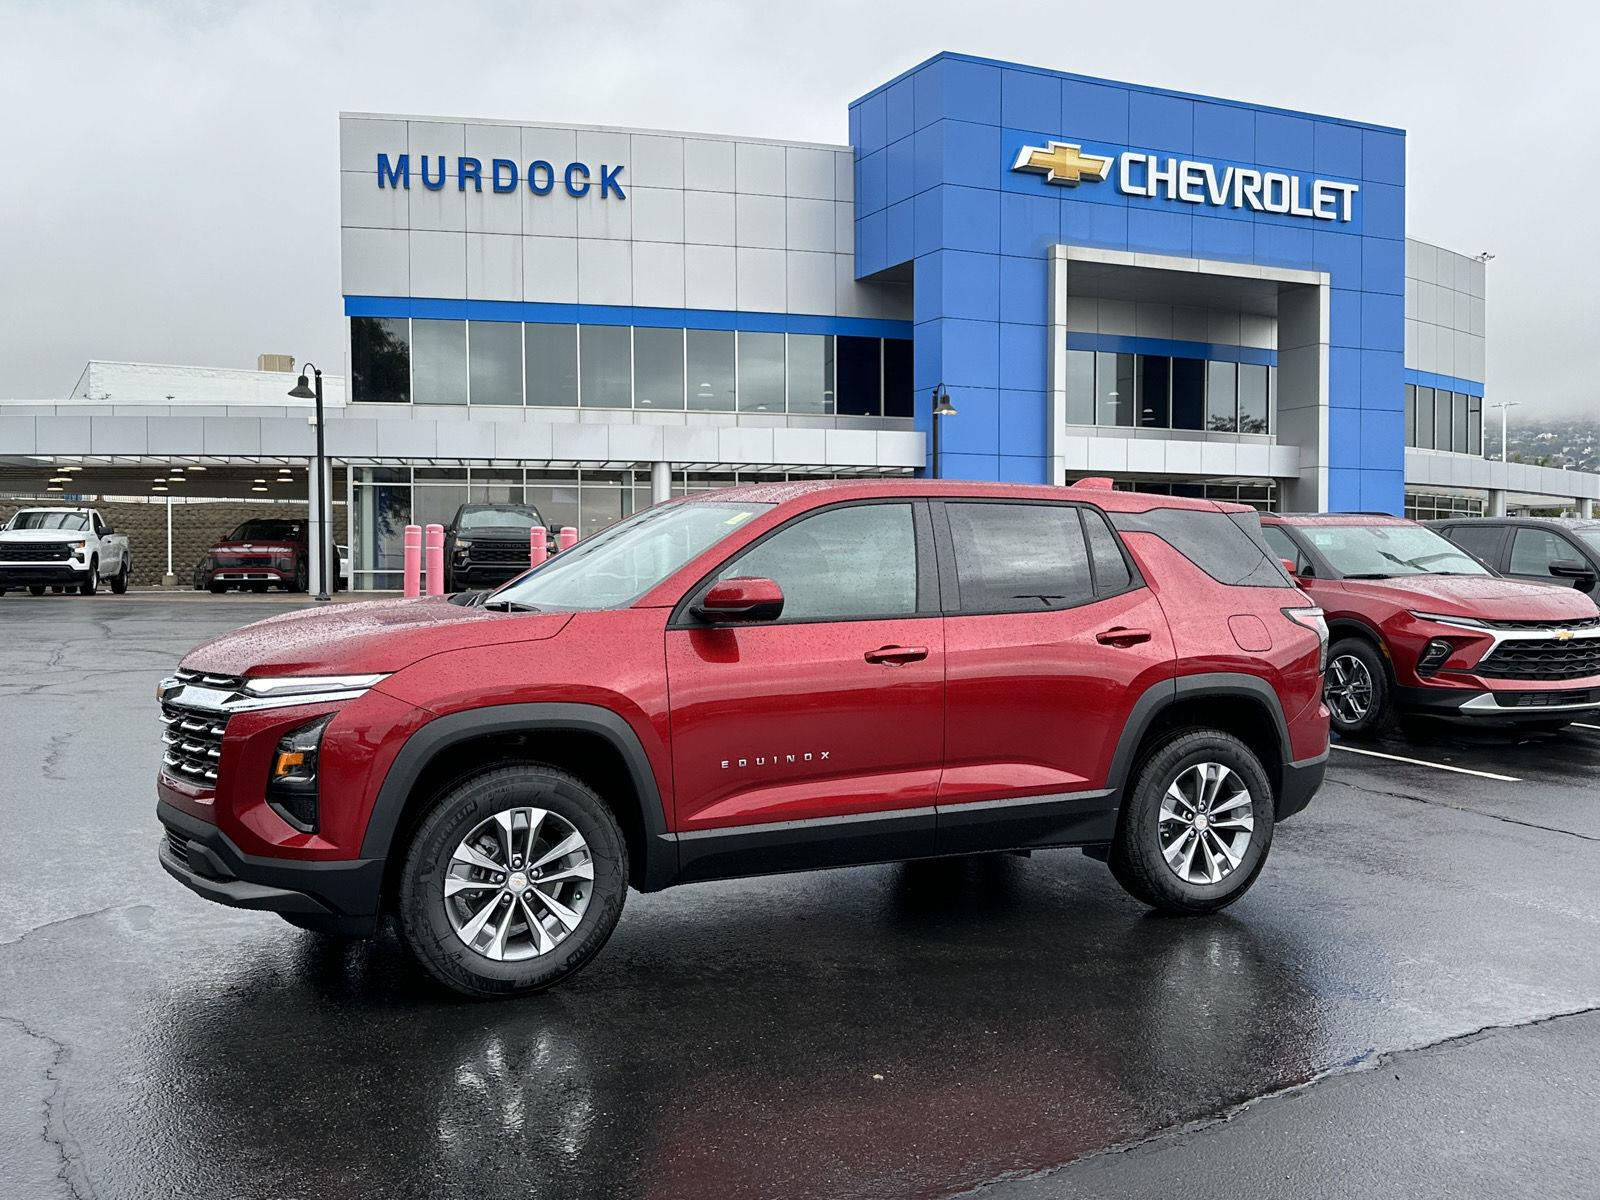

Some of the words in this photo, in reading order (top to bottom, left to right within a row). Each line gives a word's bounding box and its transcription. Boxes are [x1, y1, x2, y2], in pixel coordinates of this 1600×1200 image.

[377, 153, 627, 200] MURDOCK
[1119, 151, 1359, 222] CHEVROLET
[721, 751, 830, 769] EQUINOX
